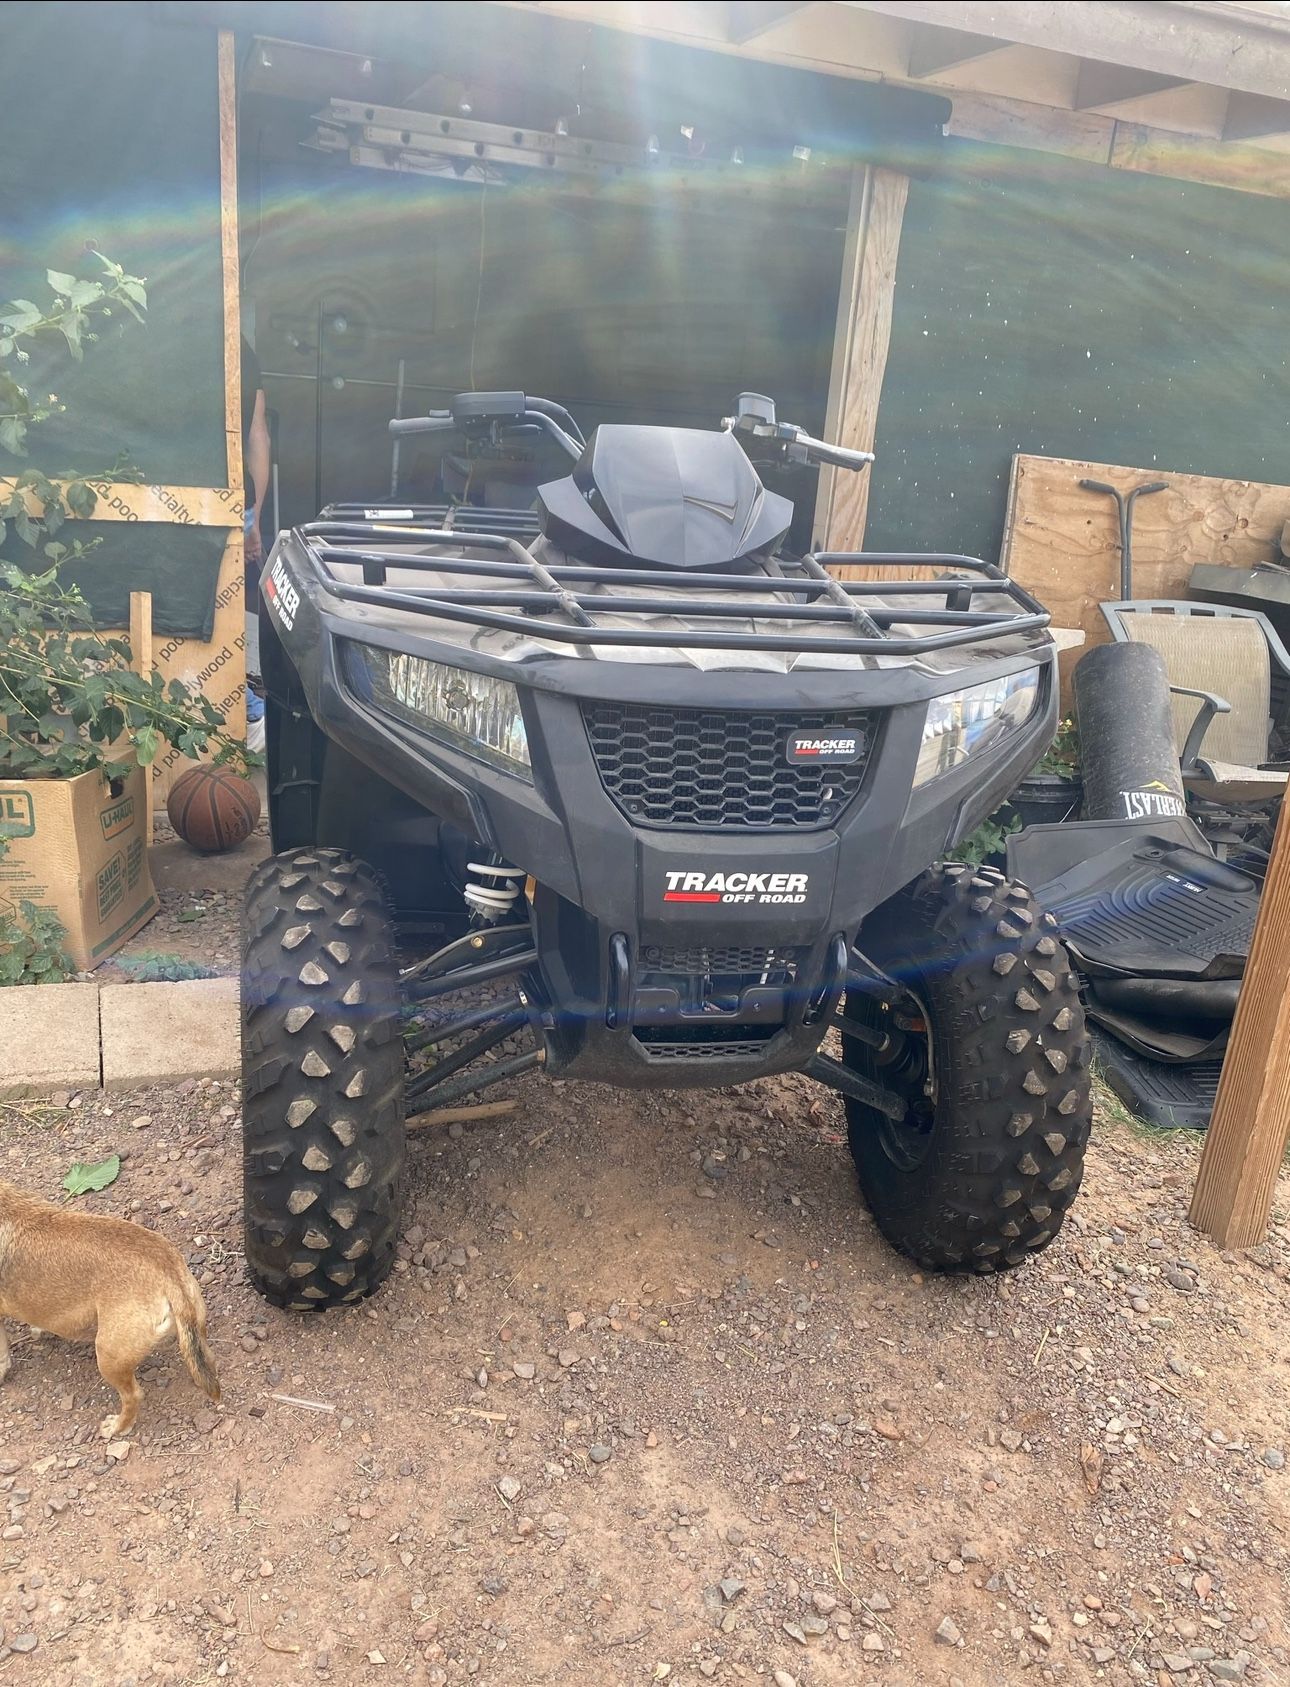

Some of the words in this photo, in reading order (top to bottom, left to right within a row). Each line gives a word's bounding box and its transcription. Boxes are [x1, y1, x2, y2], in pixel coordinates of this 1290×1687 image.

[271, 555, 300, 620] TRACKER
[795, 740, 855, 750] TRACKER
[0, 798, 25, 819] L
[665, 871, 809, 892] TRACKER
[722, 894, 756, 903] OFF
[759, 894, 806, 903] ROAD
